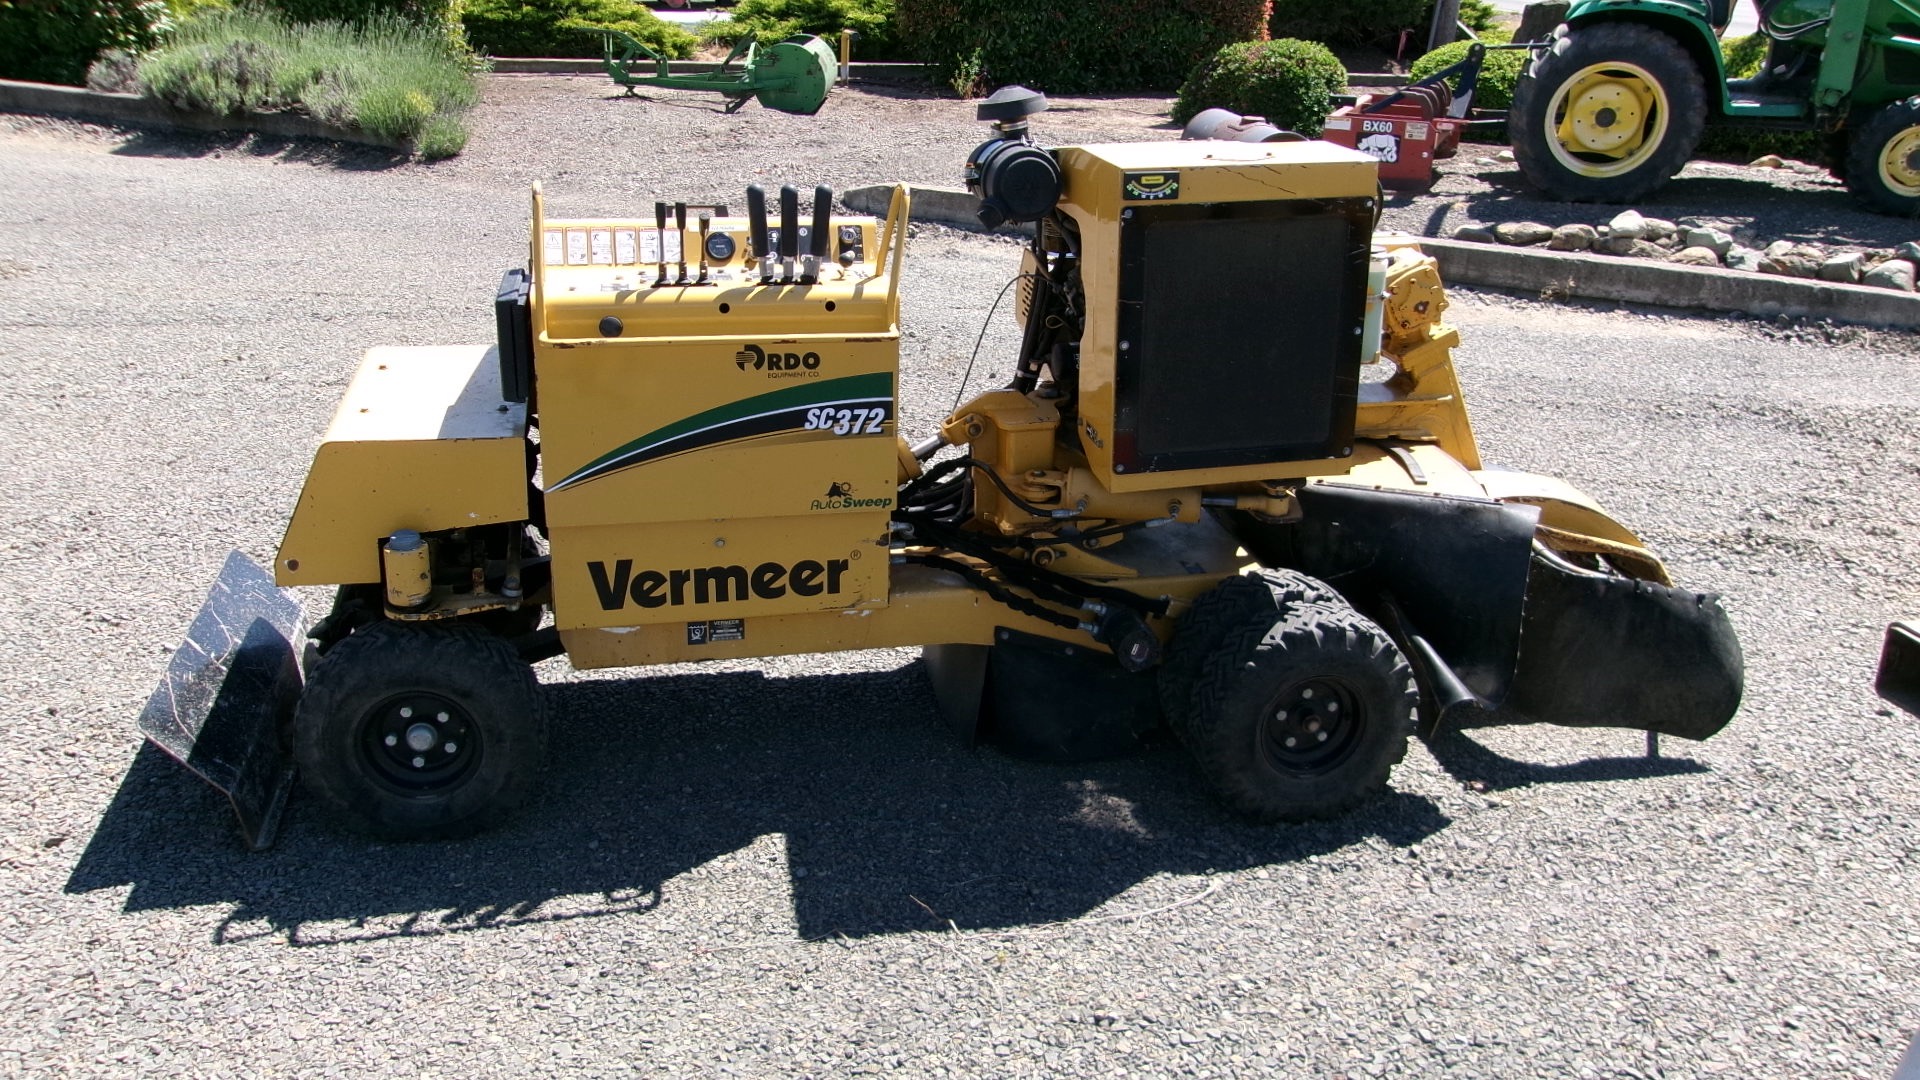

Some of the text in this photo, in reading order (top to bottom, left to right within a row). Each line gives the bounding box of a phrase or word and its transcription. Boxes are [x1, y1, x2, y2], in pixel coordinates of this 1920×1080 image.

[1363, 120, 1392, 132] BX60
[767, 371, 806, 379] EQUIPMENT
[804, 408, 886, 435] SC372
[810, 497, 892, 510] AutoSweep
